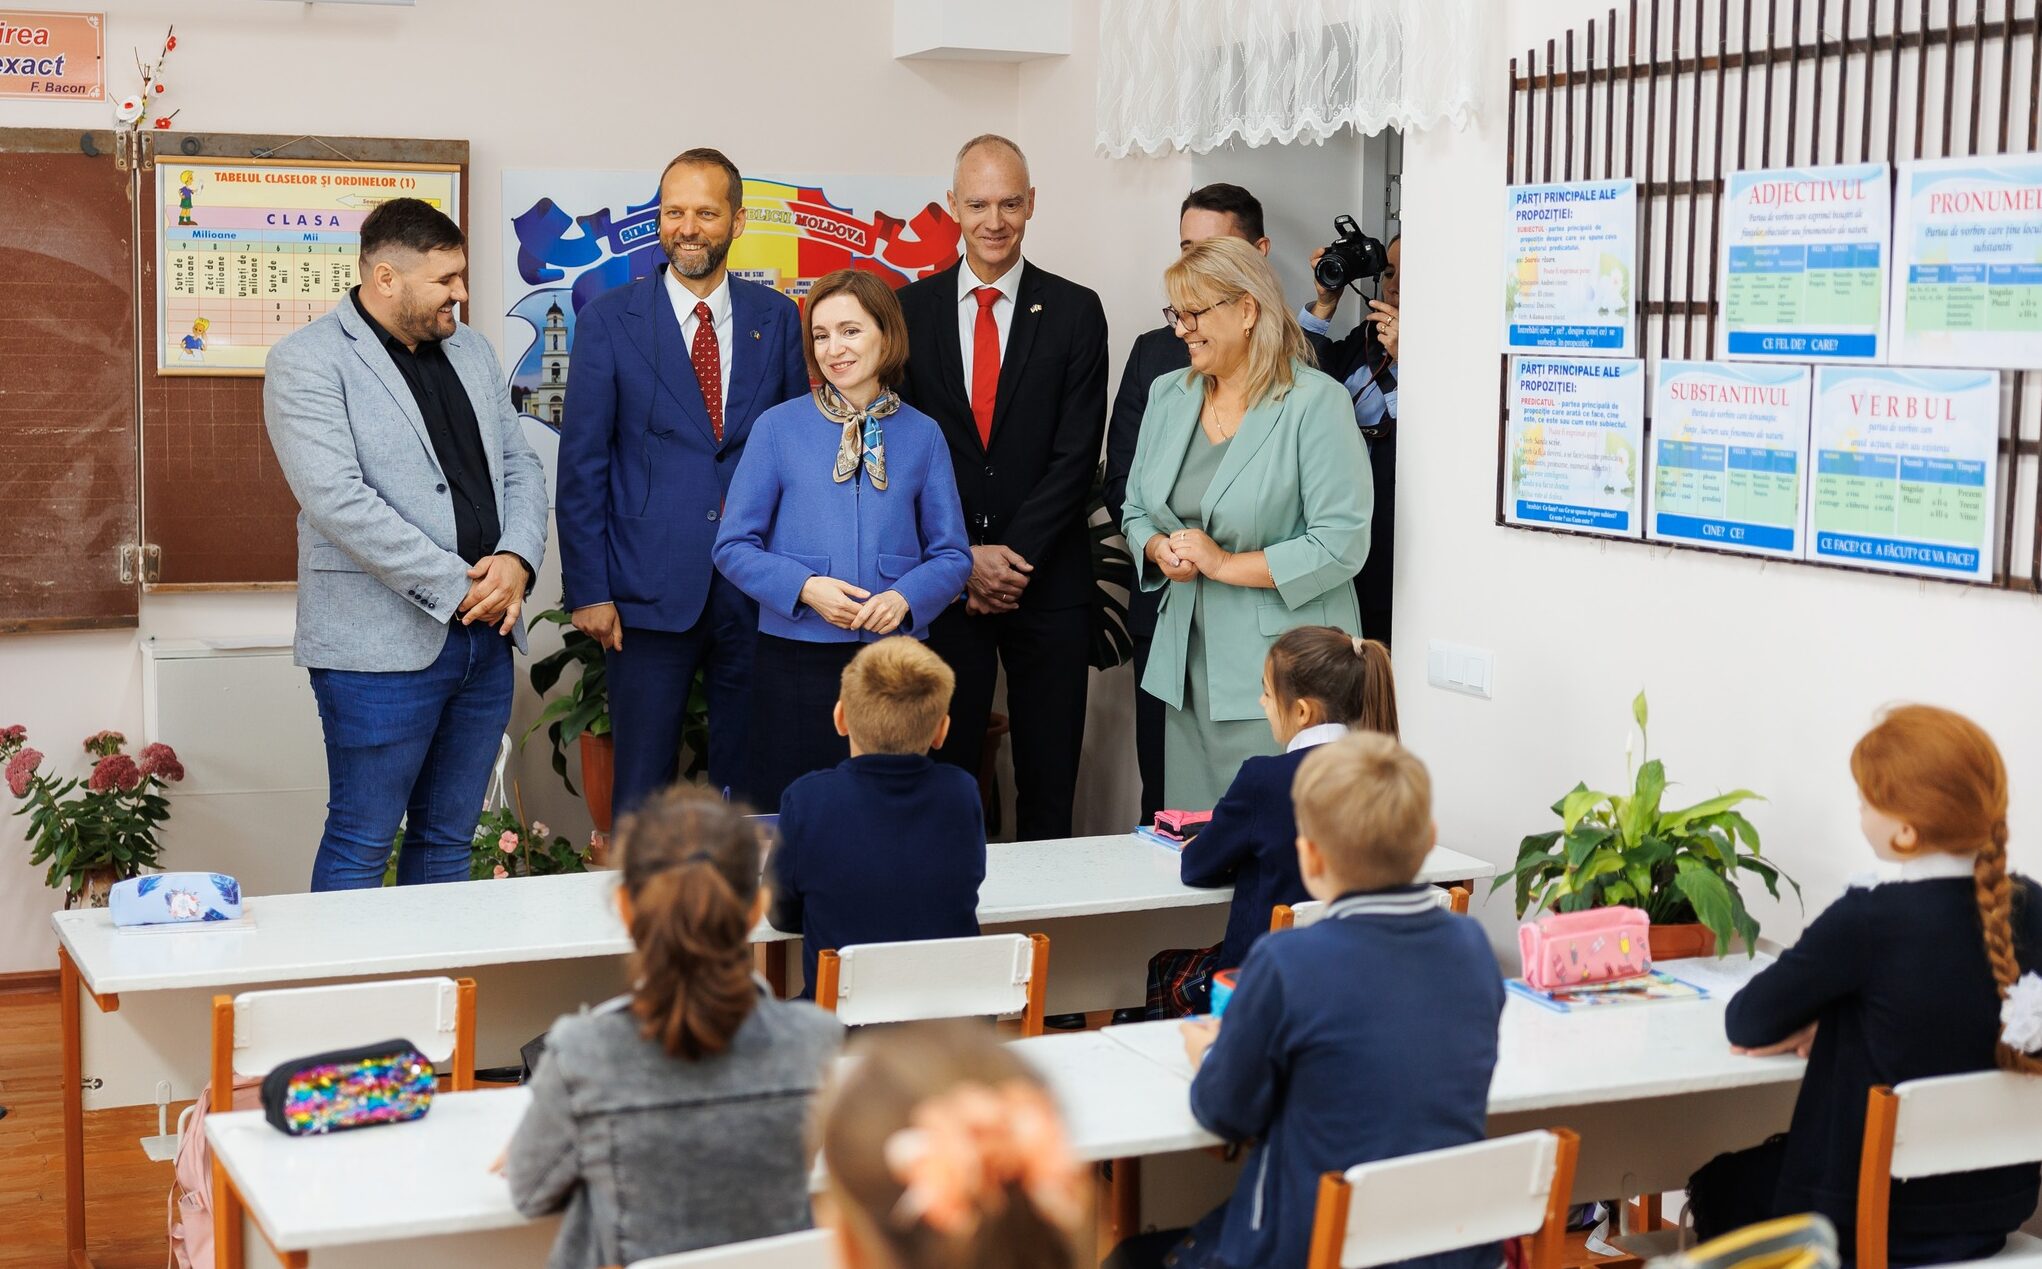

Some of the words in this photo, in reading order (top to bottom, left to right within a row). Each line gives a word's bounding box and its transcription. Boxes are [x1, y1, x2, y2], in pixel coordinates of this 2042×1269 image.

[30, 81, 40, 92] F.
[45, 82, 86, 94] Bacon
[214, 172, 262, 184] TABELUL
[264, 174, 318, 186] CLASELOR
[335, 176, 397, 188] ORDINELOR
[399, 178, 416, 190] (1)
[1544, 190, 1596, 203] PRINCIPALE
[1599, 189, 1616, 200] ALE
[1749, 178, 1866, 208] ADJECTIVUL
[266, 213, 341, 228] CLASA
[192, 230, 237, 240] Milioane
[303, 233, 318, 242] Mii
[794, 213, 868, 247] MOLDOVA
[174, 258, 183, 269] de
[204, 259, 214, 270] de
[237, 254, 246, 265] de
[268, 260, 277, 271] de
[300, 262, 310, 272] de
[342, 264, 350, 278] mii
[175, 272, 184, 291] Sute
[185, 255, 194, 294] milioane
[216, 256, 225, 294] milioane
[248, 258, 258, 294] milioane
[279, 270, 288, 284] mii
[312, 270, 320, 284] mii
[205, 274, 214, 291] Zeci
[268, 274, 278, 292] Sute
[300, 276, 310, 292] Zeci
[1762, 338, 1774, 350] CE
[1775, 338, 1790, 350] FEL
[1791, 338, 1806, 350] DE?
[1811, 338, 1839, 352] CARE?
[1548, 364, 1600, 377] PRINCIPALE
[1603, 366, 1620, 378] ALE
[1670, 382, 1790, 406] SUBSTANTIVUL
[1520, 398, 1556, 407] PREDICATUL
[1851, 394, 1957, 422] VERBUL
[1702, 524, 1726, 537] CINE?
[1821, 537, 1833, 550] CE
[1834, 538, 1860, 552] FACE?
[1860, 541, 1872, 554] CE
[1876, 542, 1883, 556] A
[1918, 546, 1932, 562] CE
[1932, 548, 1946, 563] VA
[1946, 550, 1976, 567] FACE?
